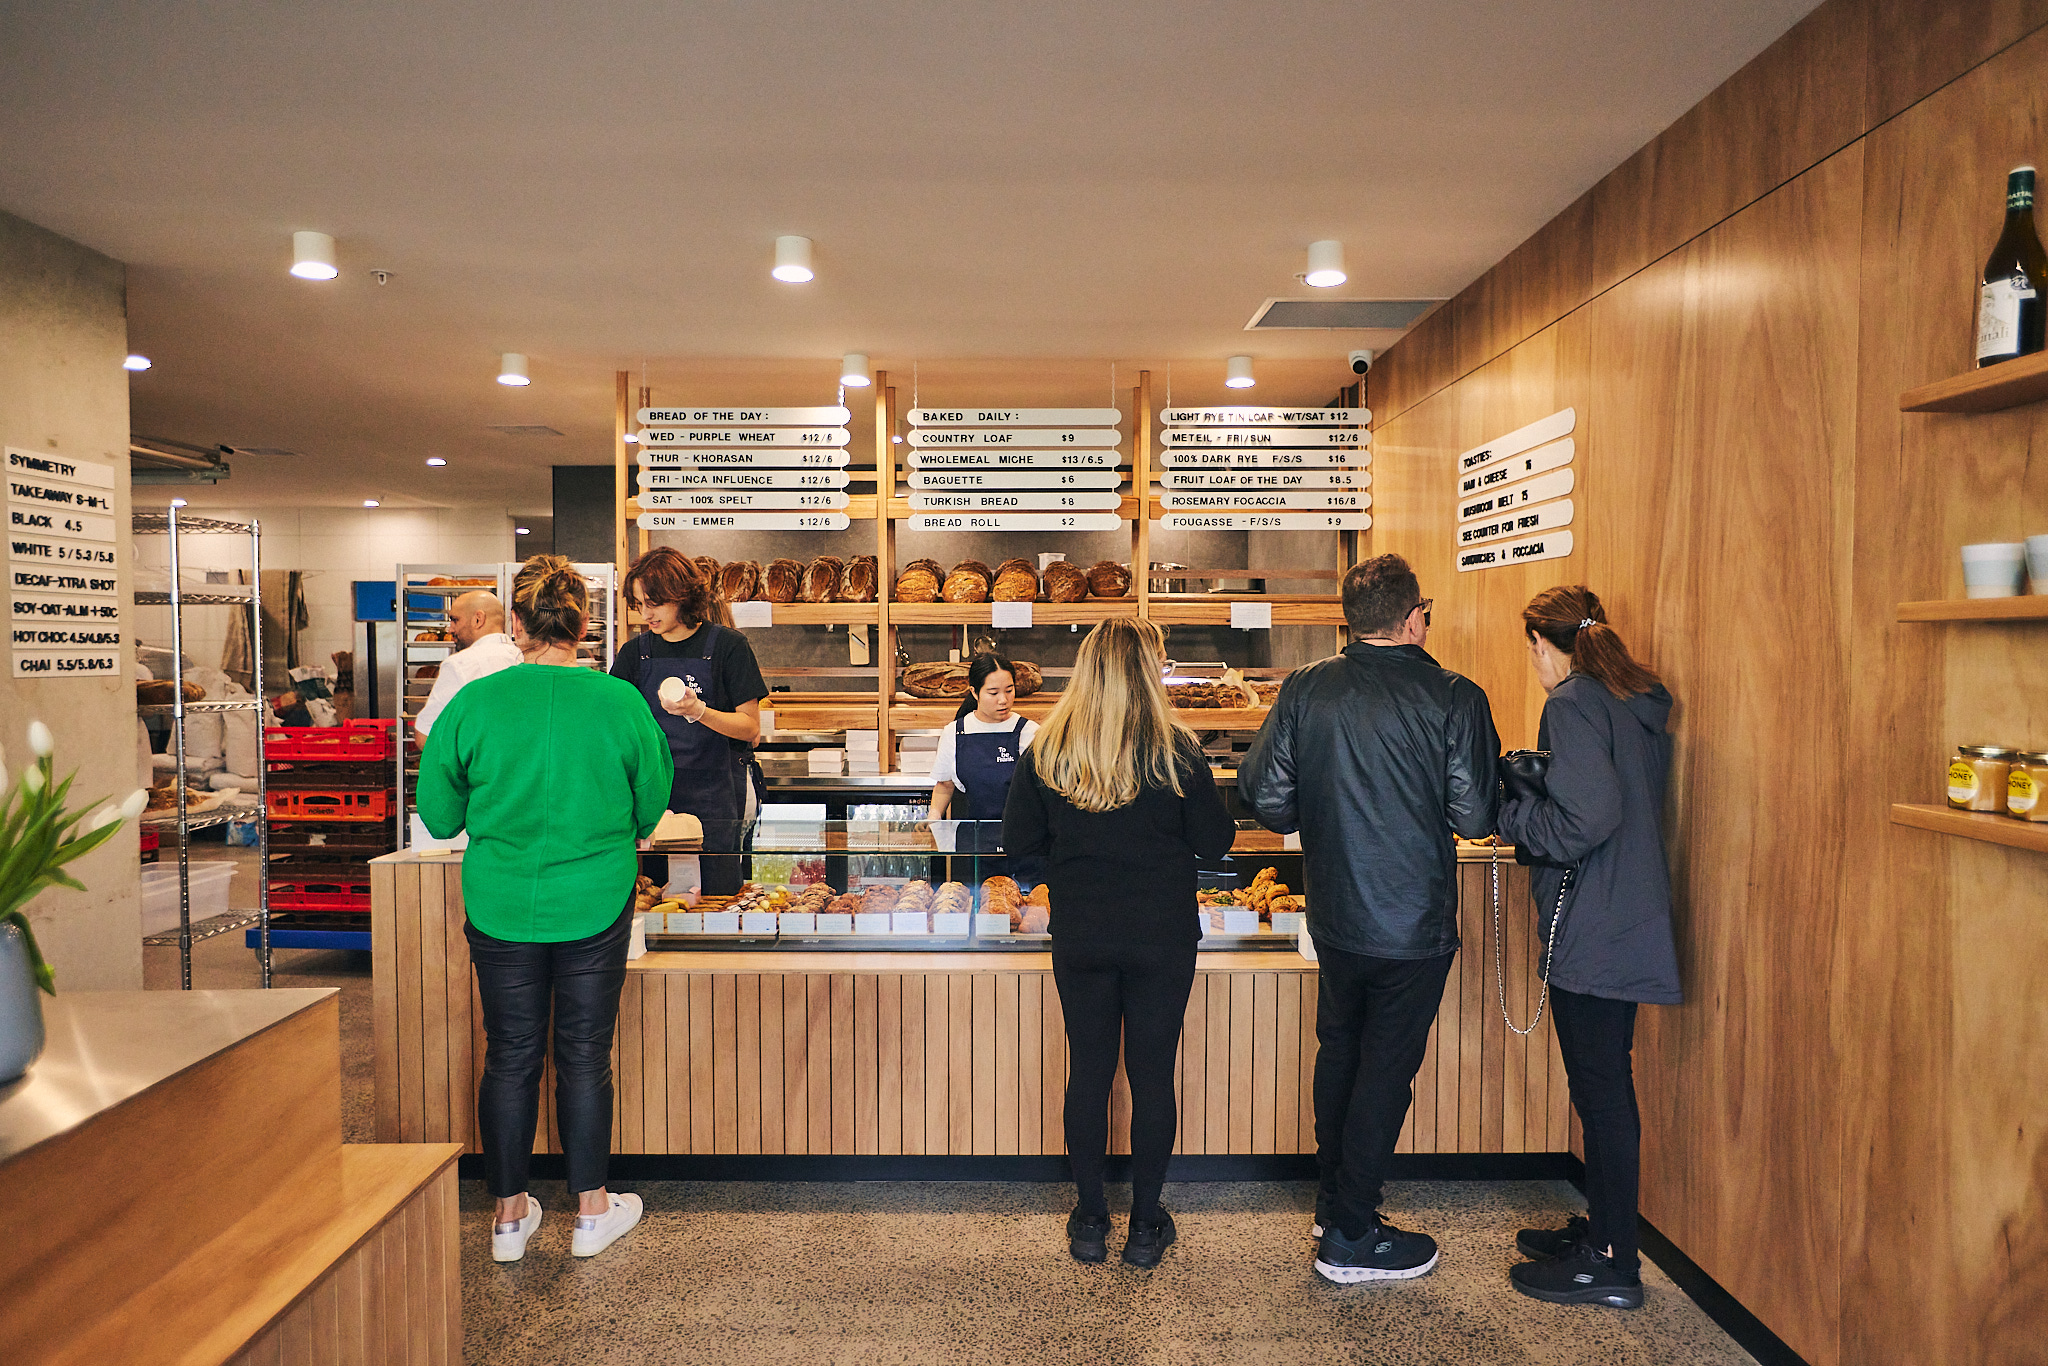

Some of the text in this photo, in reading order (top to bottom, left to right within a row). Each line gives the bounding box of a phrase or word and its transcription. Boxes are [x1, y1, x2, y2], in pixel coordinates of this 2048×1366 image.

[650, 412, 686, 420] BREAD
[694, 412, 708, 420] OF
[713, 412, 733, 420] THE
[923, 413, 963, 421] BAKED
[1205, 413, 1223, 421] RYE
[1249, 413, 1273, 421] LOAF
[1331, 412, 1348, 420] $12
[690, 433, 730, 441] PURPLE
[739, 433, 775, 441] WHEAT
[1062, 434, 1074, 442] $9
[1173, 434, 1211, 442] METEIL
[1329, 434, 1358, 442] $12/6
[650, 454, 678, 462] THUR
[1464, 451, 1492, 468] TOASTIES:
[10, 454, 75, 476] SYMMETRY
[713, 476, 772, 484] INFLUENCE
[801, 476, 830, 484] $12/6
[924, 476, 982, 484] BAGUETTE
[1330, 476, 1351, 484] $8.5
[1484, 469, 1508, 485] CHEESE
[11, 483, 108, 509] TAKEAWAY S-M-L
[801, 496, 831, 504] $12/6
[1498, 494, 1513, 507] MELT
[1172, 497, 1229, 505] ROSEMARY
[12, 512, 82, 531] BLACK 4.5
[1174, 518, 1232, 526] FOUGASSE
[1463, 515, 1538, 541] SEE COUNTER FOR FRESH
[12, 542, 51, 556] WHITE
[90, 579, 116, 590] SHOT
[14, 631, 37, 642] HOT
[38, 632, 68, 642] CHOC
[21, 660, 50, 671] CHAI
[1949, 771, 1973, 781] HONEY
